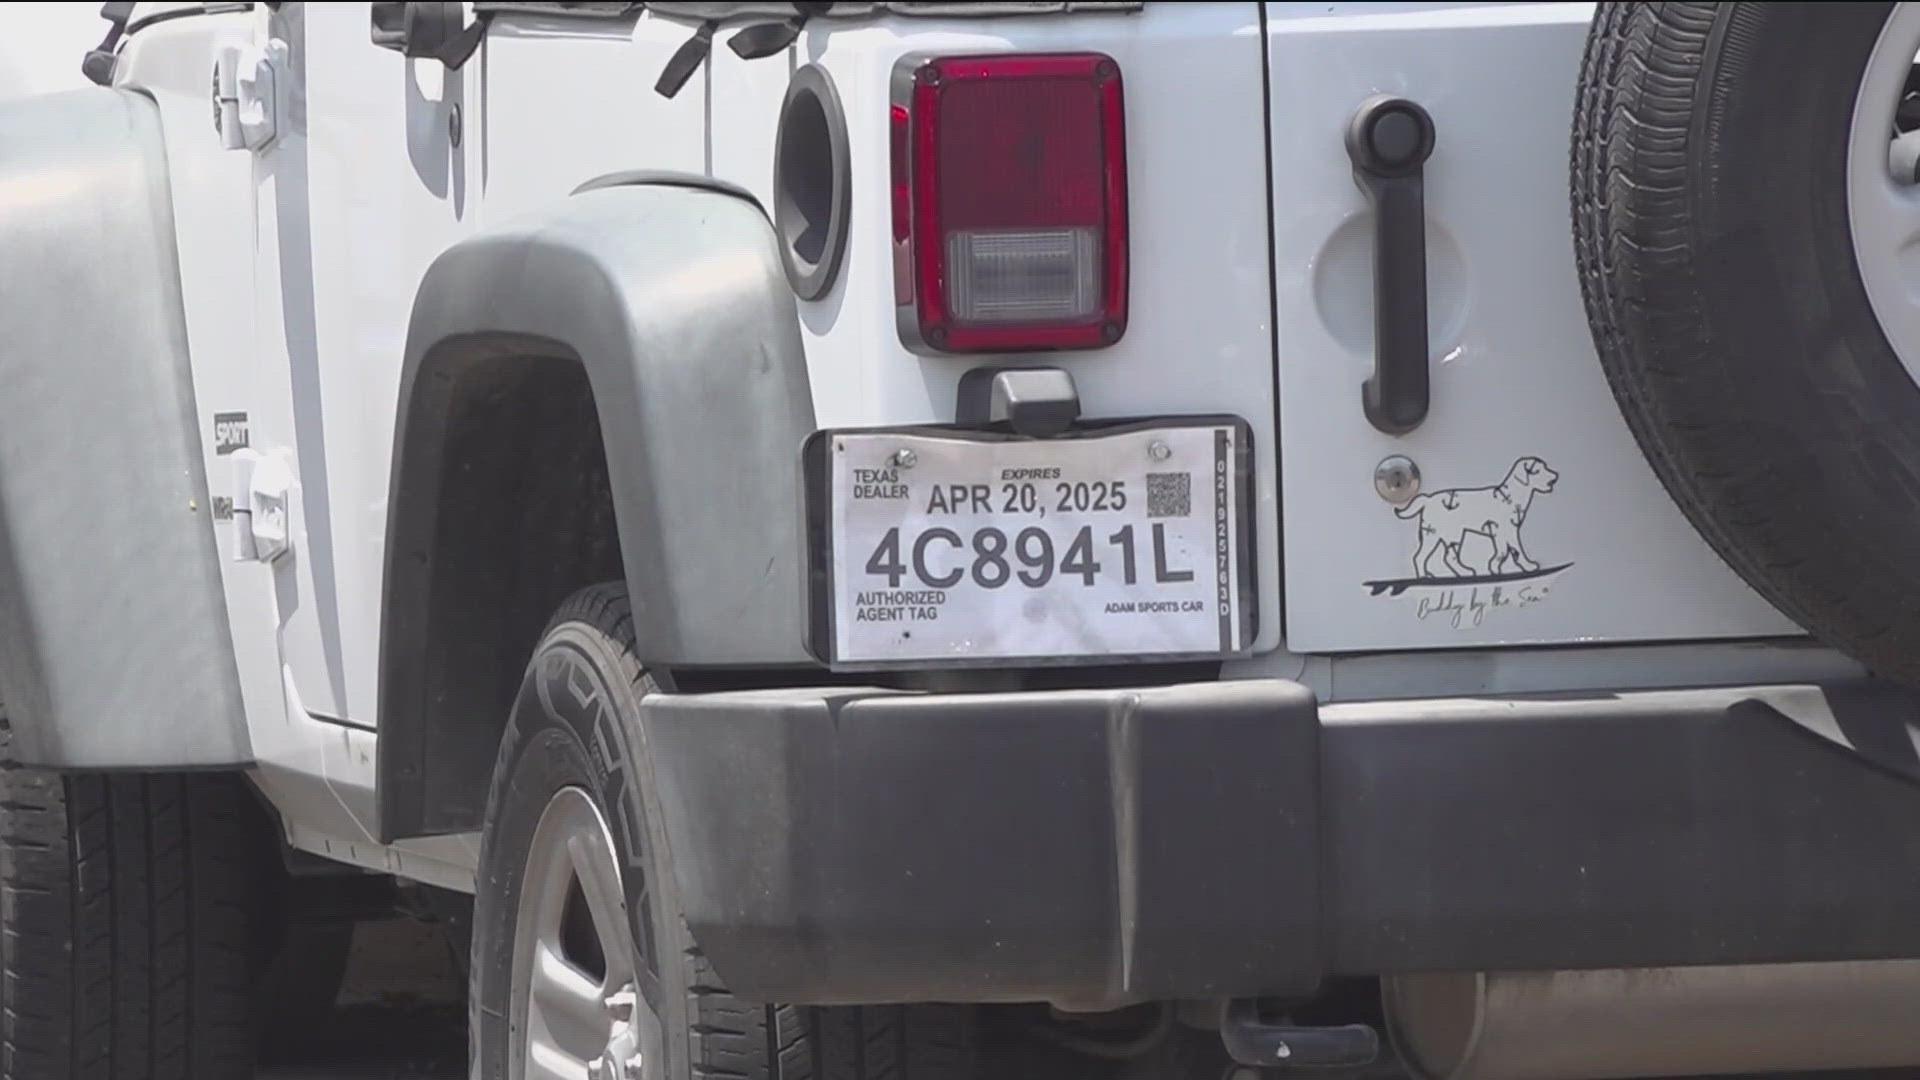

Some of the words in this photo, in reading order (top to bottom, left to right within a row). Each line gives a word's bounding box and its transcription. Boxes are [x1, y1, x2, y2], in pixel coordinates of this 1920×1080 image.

[854, 469, 899, 483] TEXAS
[1001, 468, 1061, 480] EXPIRES
[854, 485, 909, 499] DEALER
[927, 484, 993, 514] APR
[1002, 483, 1046, 518] 20,
[1056, 481, 1127, 512] 2025
[865, 523, 1194, 589] 4C8941L
[856, 591, 946, 605] AUTHORIZED
[856, 607, 904, 621] AGENT
[909, 606, 937, 620] TAG
[1104, 602, 1136, 613] ADAM
[1138, 601, 1180, 612] SPORTS
[1181, 601, 1204, 612] CAR
[1469, 587, 1487, 626] by
